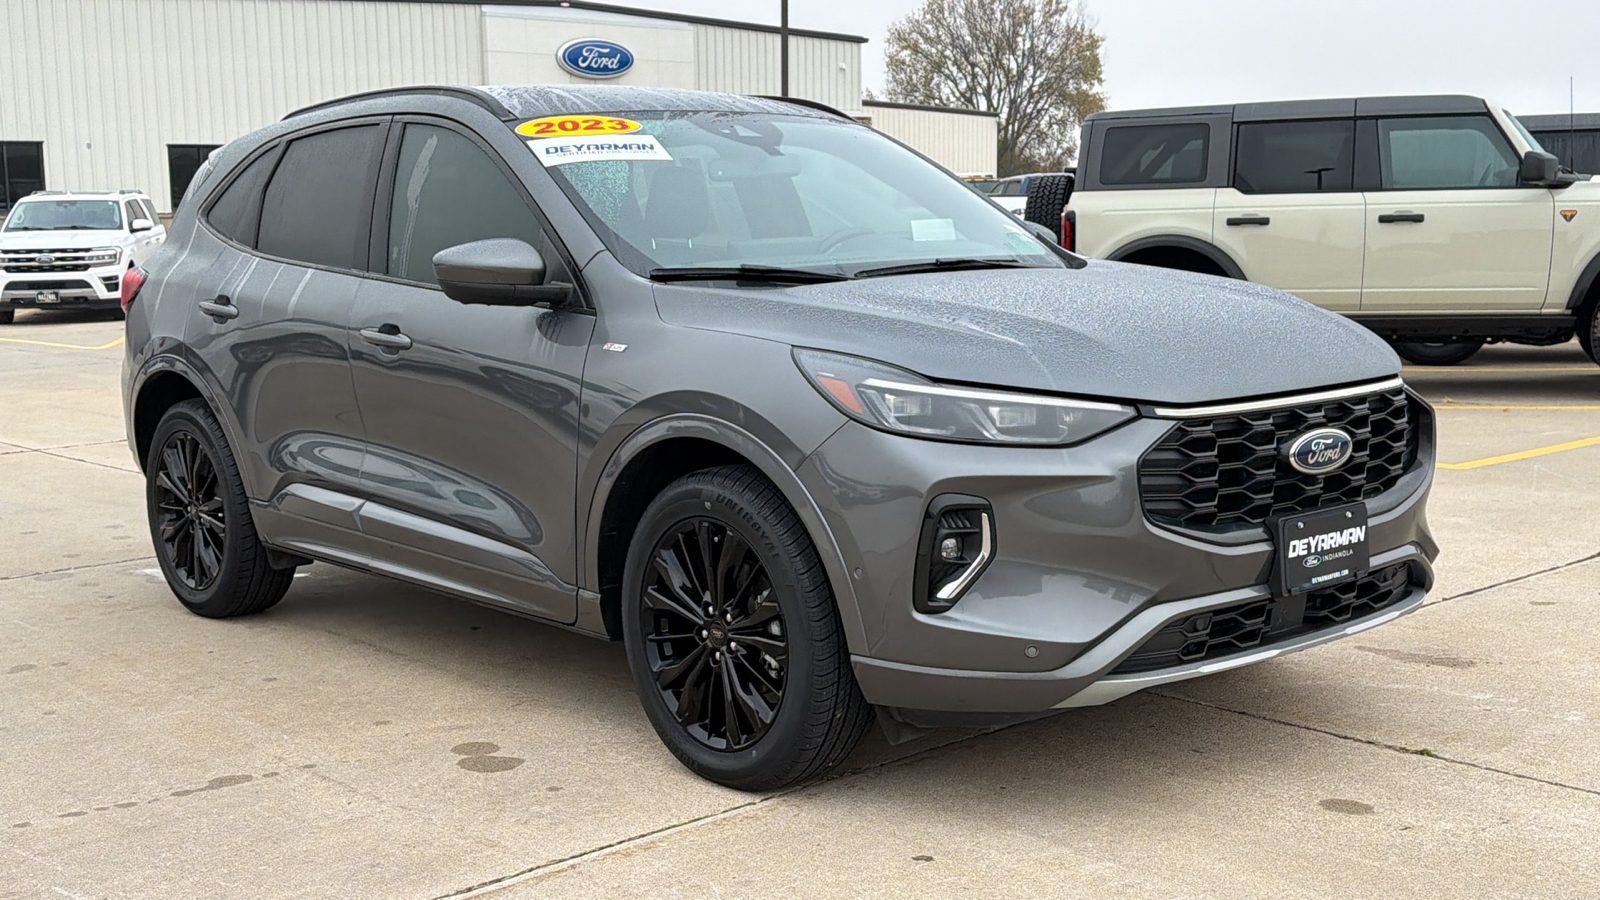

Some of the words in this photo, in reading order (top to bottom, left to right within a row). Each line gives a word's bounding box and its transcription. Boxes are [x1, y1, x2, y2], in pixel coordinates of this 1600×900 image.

[578, 46, 620, 69] Ford
[533, 119, 631, 135] 2023
[545, 143, 655, 154] DEYARMAN
[1308, 438, 1341, 464] Ford
[715, 494, 780, 559] UNIROYAL
[1288, 525, 1366, 559] DEYARMAN
[1322, 548, 1354, 562] INDIANOLA
